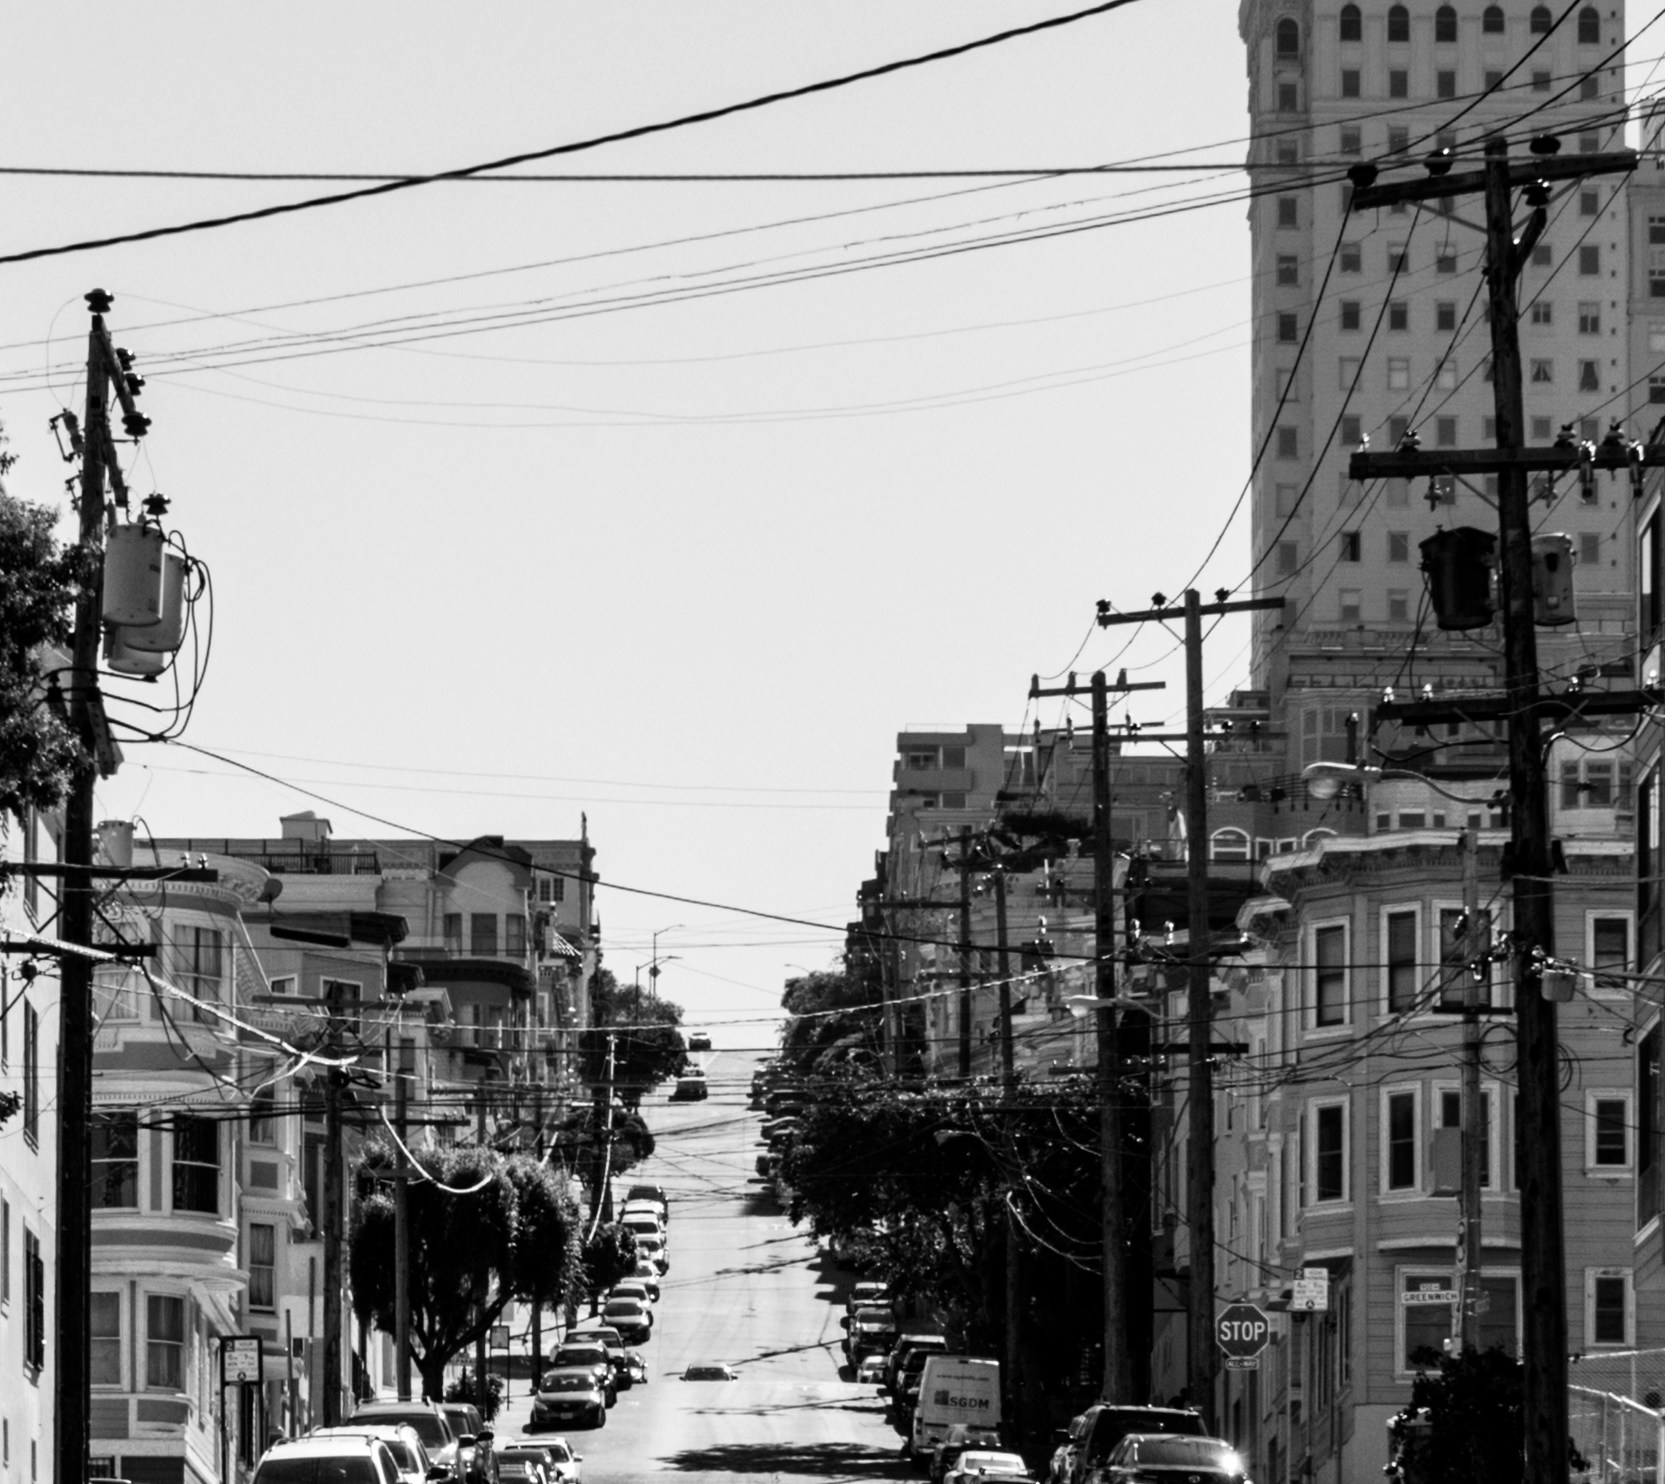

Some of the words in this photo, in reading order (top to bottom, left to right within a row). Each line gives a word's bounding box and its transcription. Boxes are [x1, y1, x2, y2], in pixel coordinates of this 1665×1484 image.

[1403, 1292, 1457, 1302] GREENWICH
[1220, 1321, 1266, 1341] STOP
[949, 1396, 990, 1410] SGDM
